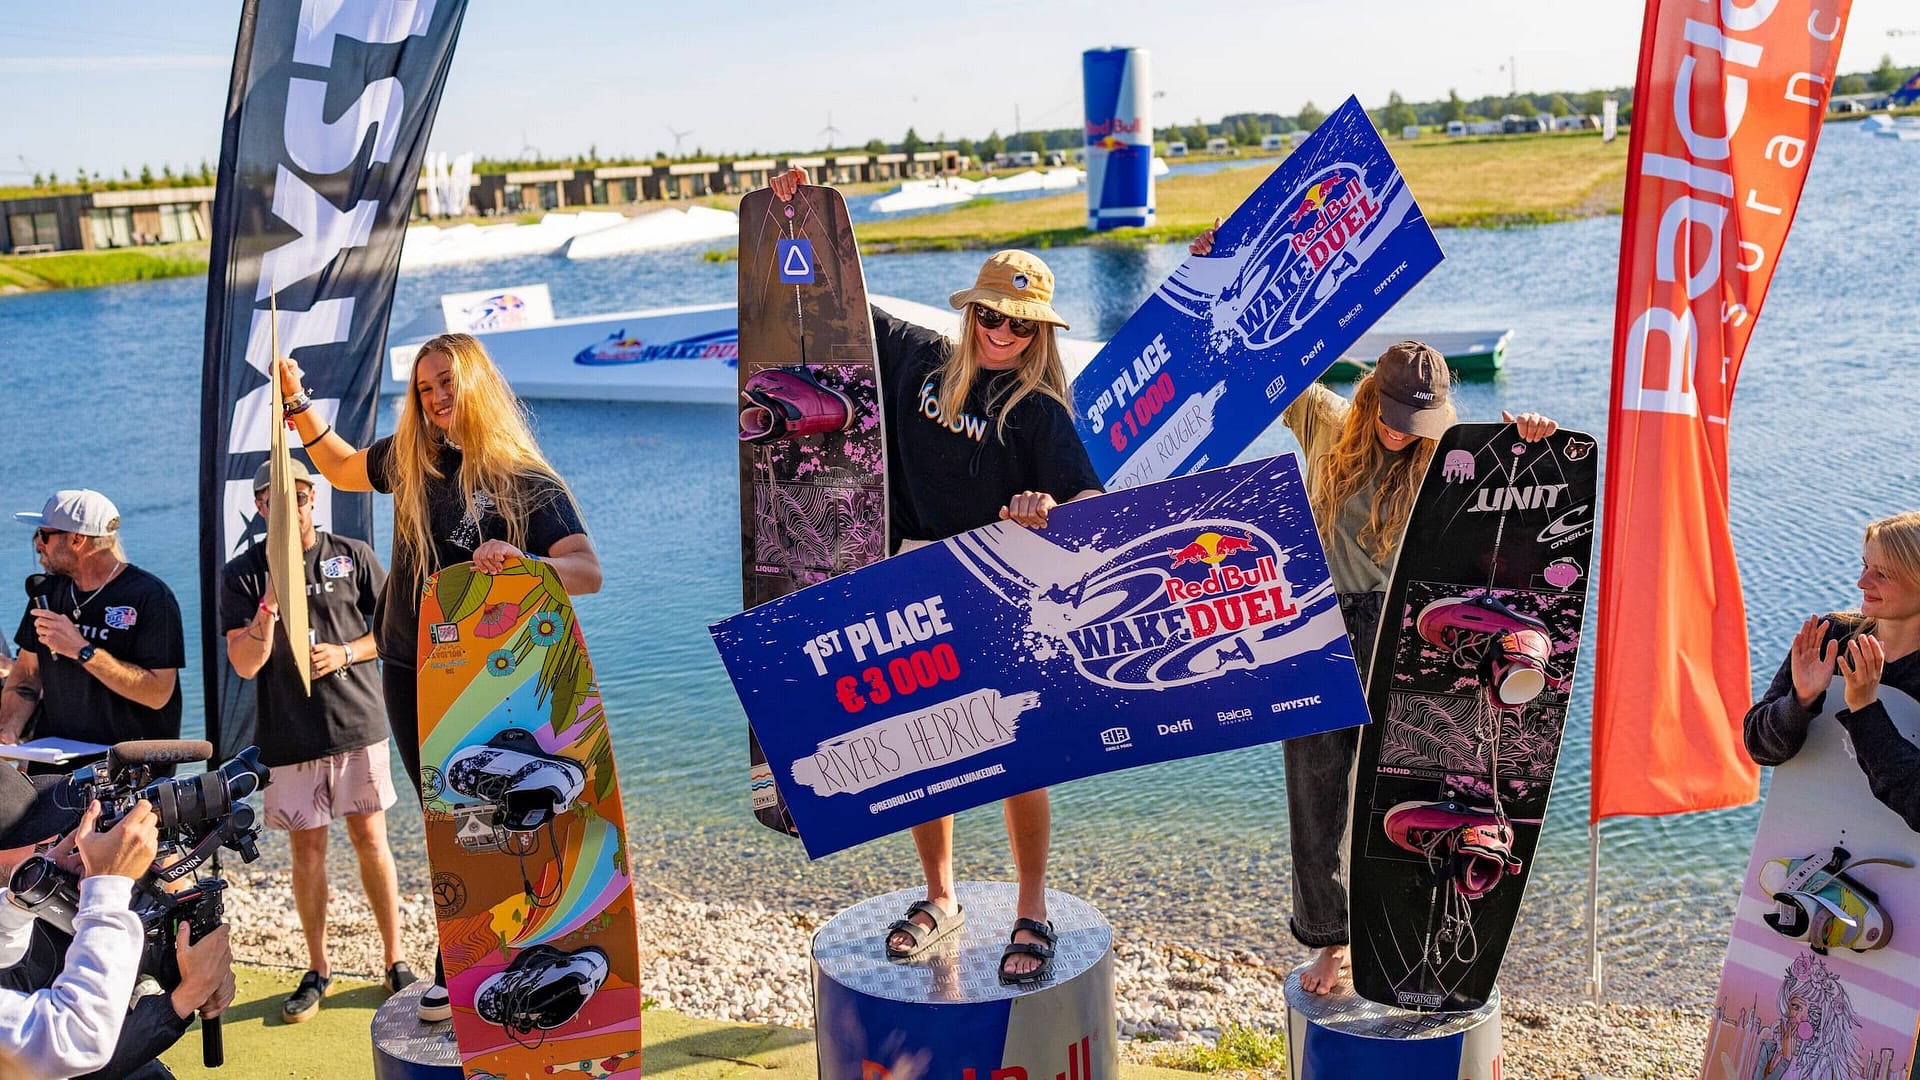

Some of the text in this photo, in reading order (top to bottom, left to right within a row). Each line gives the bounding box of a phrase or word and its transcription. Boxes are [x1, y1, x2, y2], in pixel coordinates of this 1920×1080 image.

[229, 0, 437, 454] MYST
[1291, 178, 1362, 253] Red Bull
[1378, 261, 1409, 291] MYSTIC
[1338, 303, 1363, 327] Balcia
[1300, 338, 1326, 366] Delfi
[1087, 333, 1172, 434] 3RD PLACE
[918, 382, 988, 443] foow
[1155, 404, 1208, 463] ROUGIER
[755, 565, 780, 574] LIQUID
[1166, 556, 1278, 602] Red Bull
[306, 581, 334, 596] TIC
[803, 595, 954, 677] 1ST PLACE
[1216, 708, 1252, 722] Balcia
[1280, 695, 1322, 712] MYSTIC
[813, 691, 1012, 792] RIVERS HEDRICK
[1157, 718, 1194, 736] Delfi
[926, 763, 1006, 796] #REDBULLWAKEDUEL
[168, 855, 202, 879] RONIN
